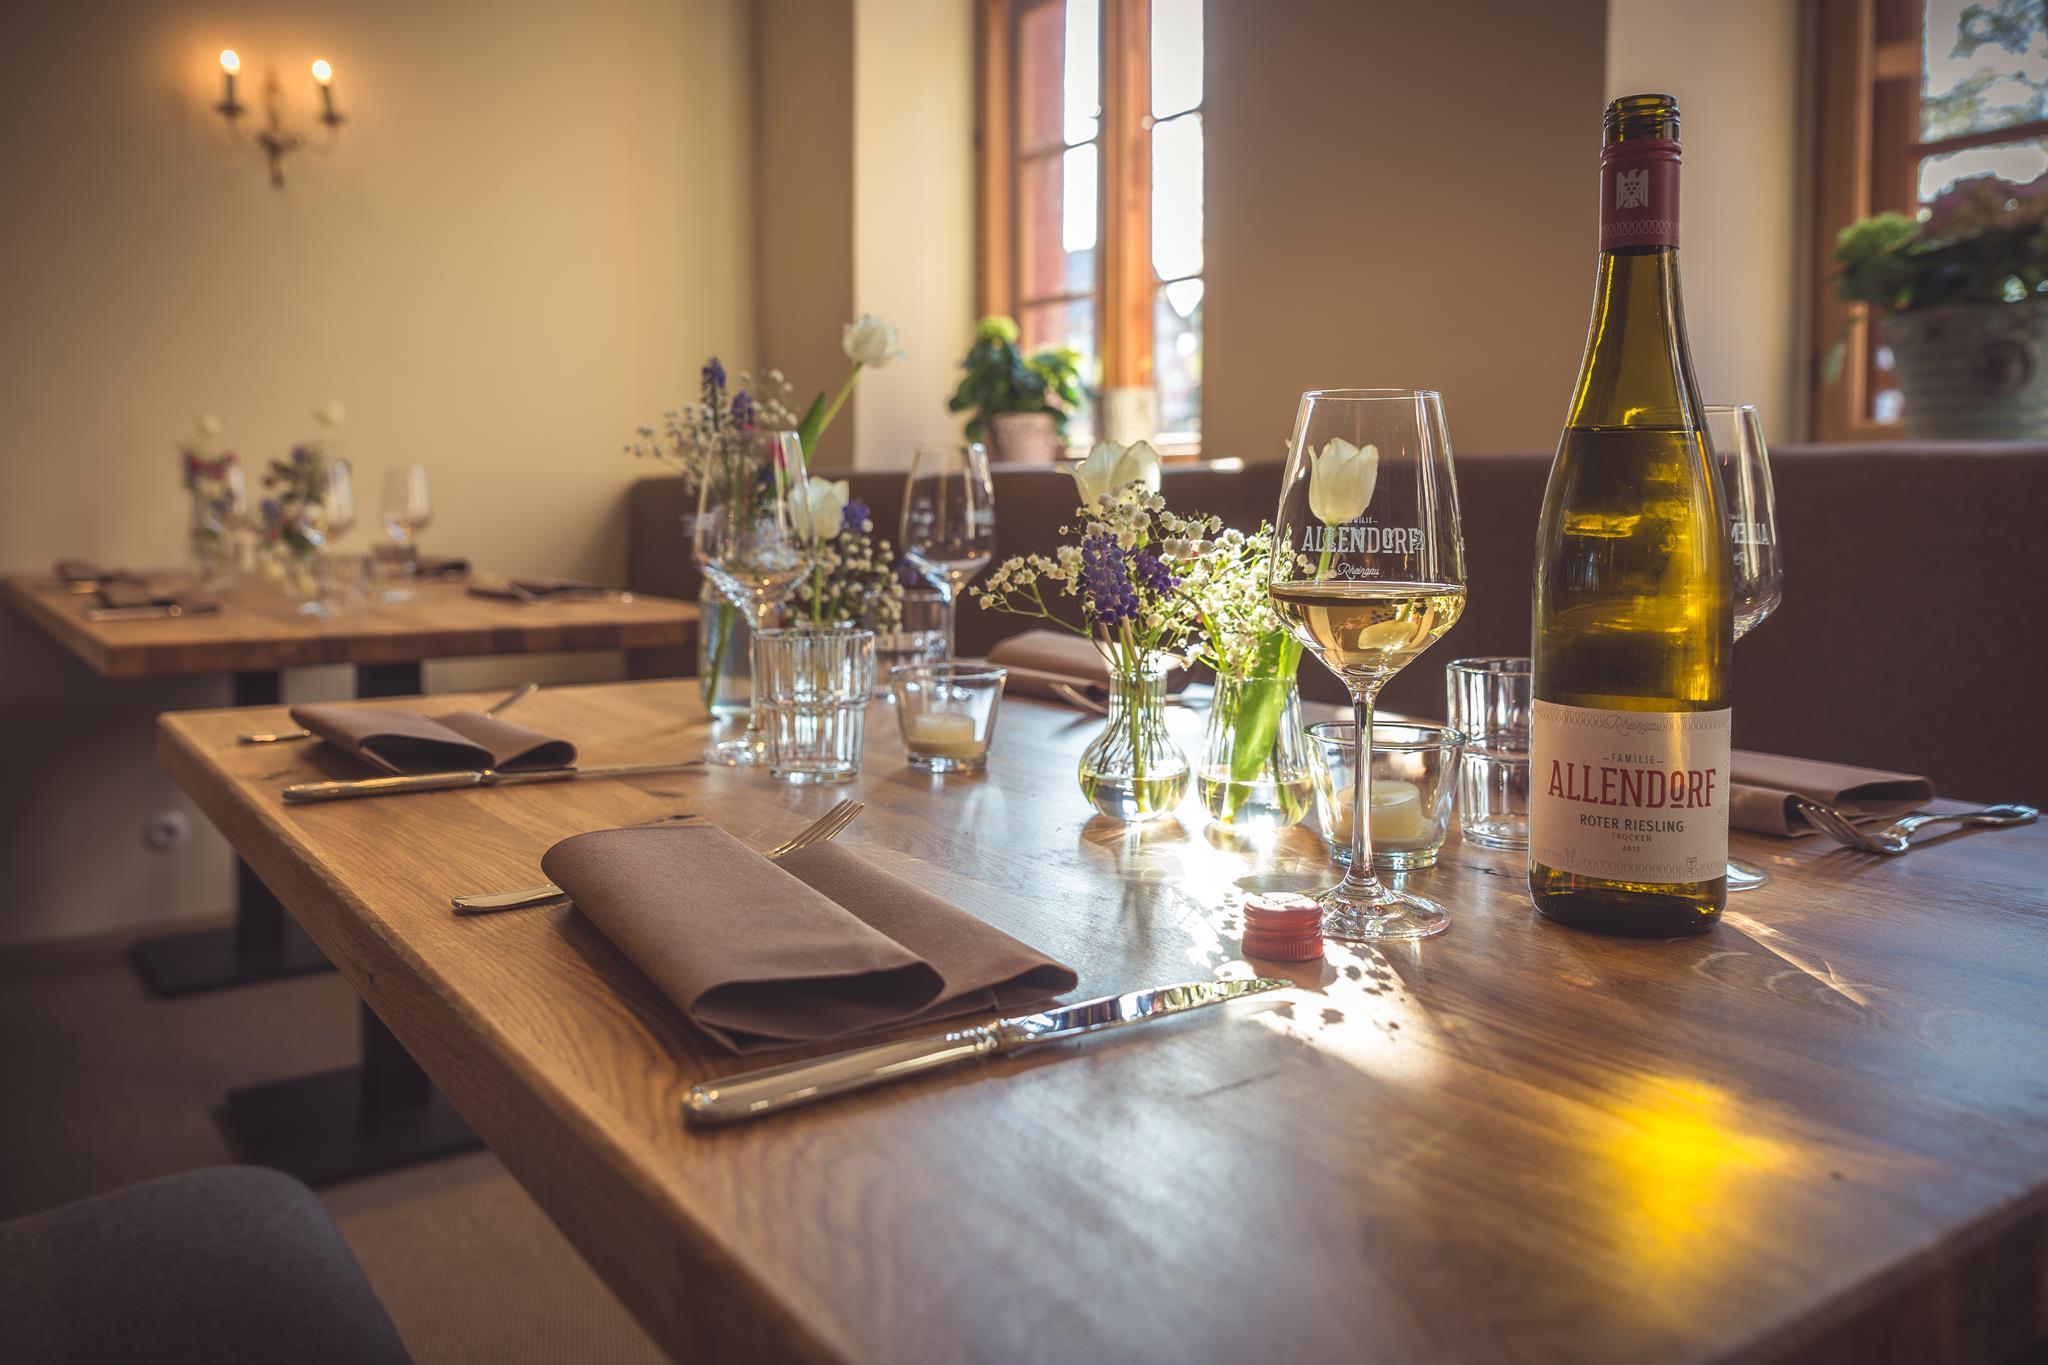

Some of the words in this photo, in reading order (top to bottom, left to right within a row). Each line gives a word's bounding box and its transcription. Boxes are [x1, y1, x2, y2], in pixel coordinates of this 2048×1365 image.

[1301, 526, 1418, 554] ALLENDORF
[1337, 562, 1380, 580] Rheingau
[1604, 714, 1664, 736] Rheingau
[1611, 752, 1655, 765] FAMILIE
[1548, 760, 1716, 809] ALLENDORF
[1580, 814, 1619, 830] ROTER
[1624, 818, 1684, 833] RIESLING
[1612, 832, 1652, 842] TROCKEN
[1622, 845, 1641, 853] 2015
